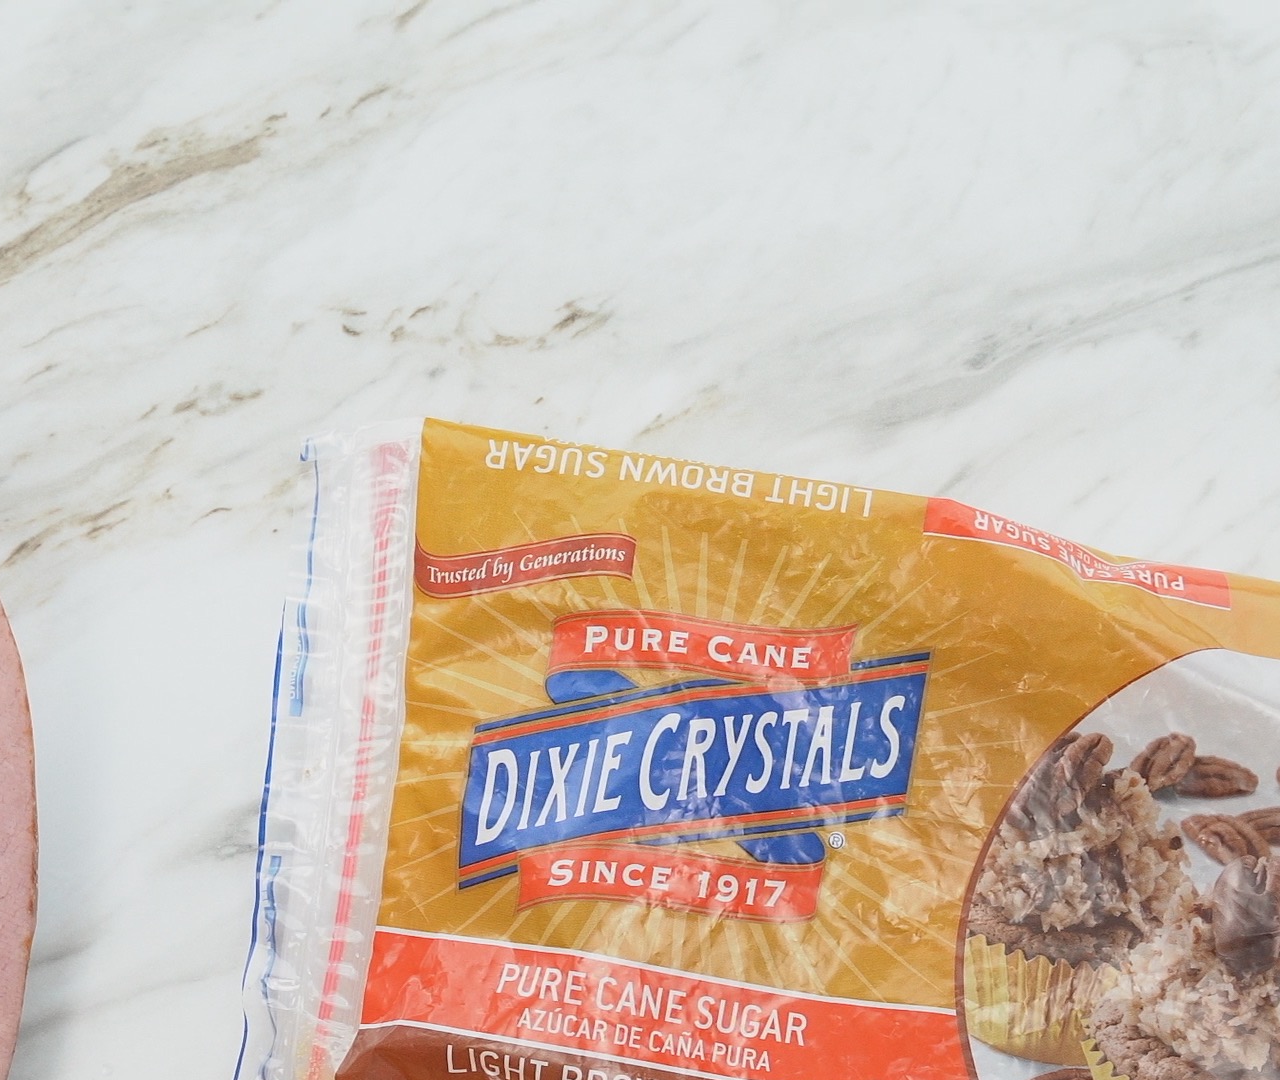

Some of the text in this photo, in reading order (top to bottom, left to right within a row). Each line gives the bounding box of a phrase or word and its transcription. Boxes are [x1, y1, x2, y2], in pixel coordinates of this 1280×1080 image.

[485, 439, 609, 479] SUGAR
[619, 455, 753, 497] BROWN
[765, 475, 873, 517] LIGHT
[974, 511, 1050, 550] SUGAR
[427, 542, 626, 584] Trusted by Generations
[1122, 568, 1185, 592] PURE
[584, 626, 812, 670] PURE CANE
[475, 695, 906, 846] DIXIE CRYSTALS
[547, 858, 787, 907] SINCE 1917
[495, 963, 808, 1046] PURE CANE SUGAR
[517, 1007, 771, 1072] AZÚCAR DE CAÑA PURA
